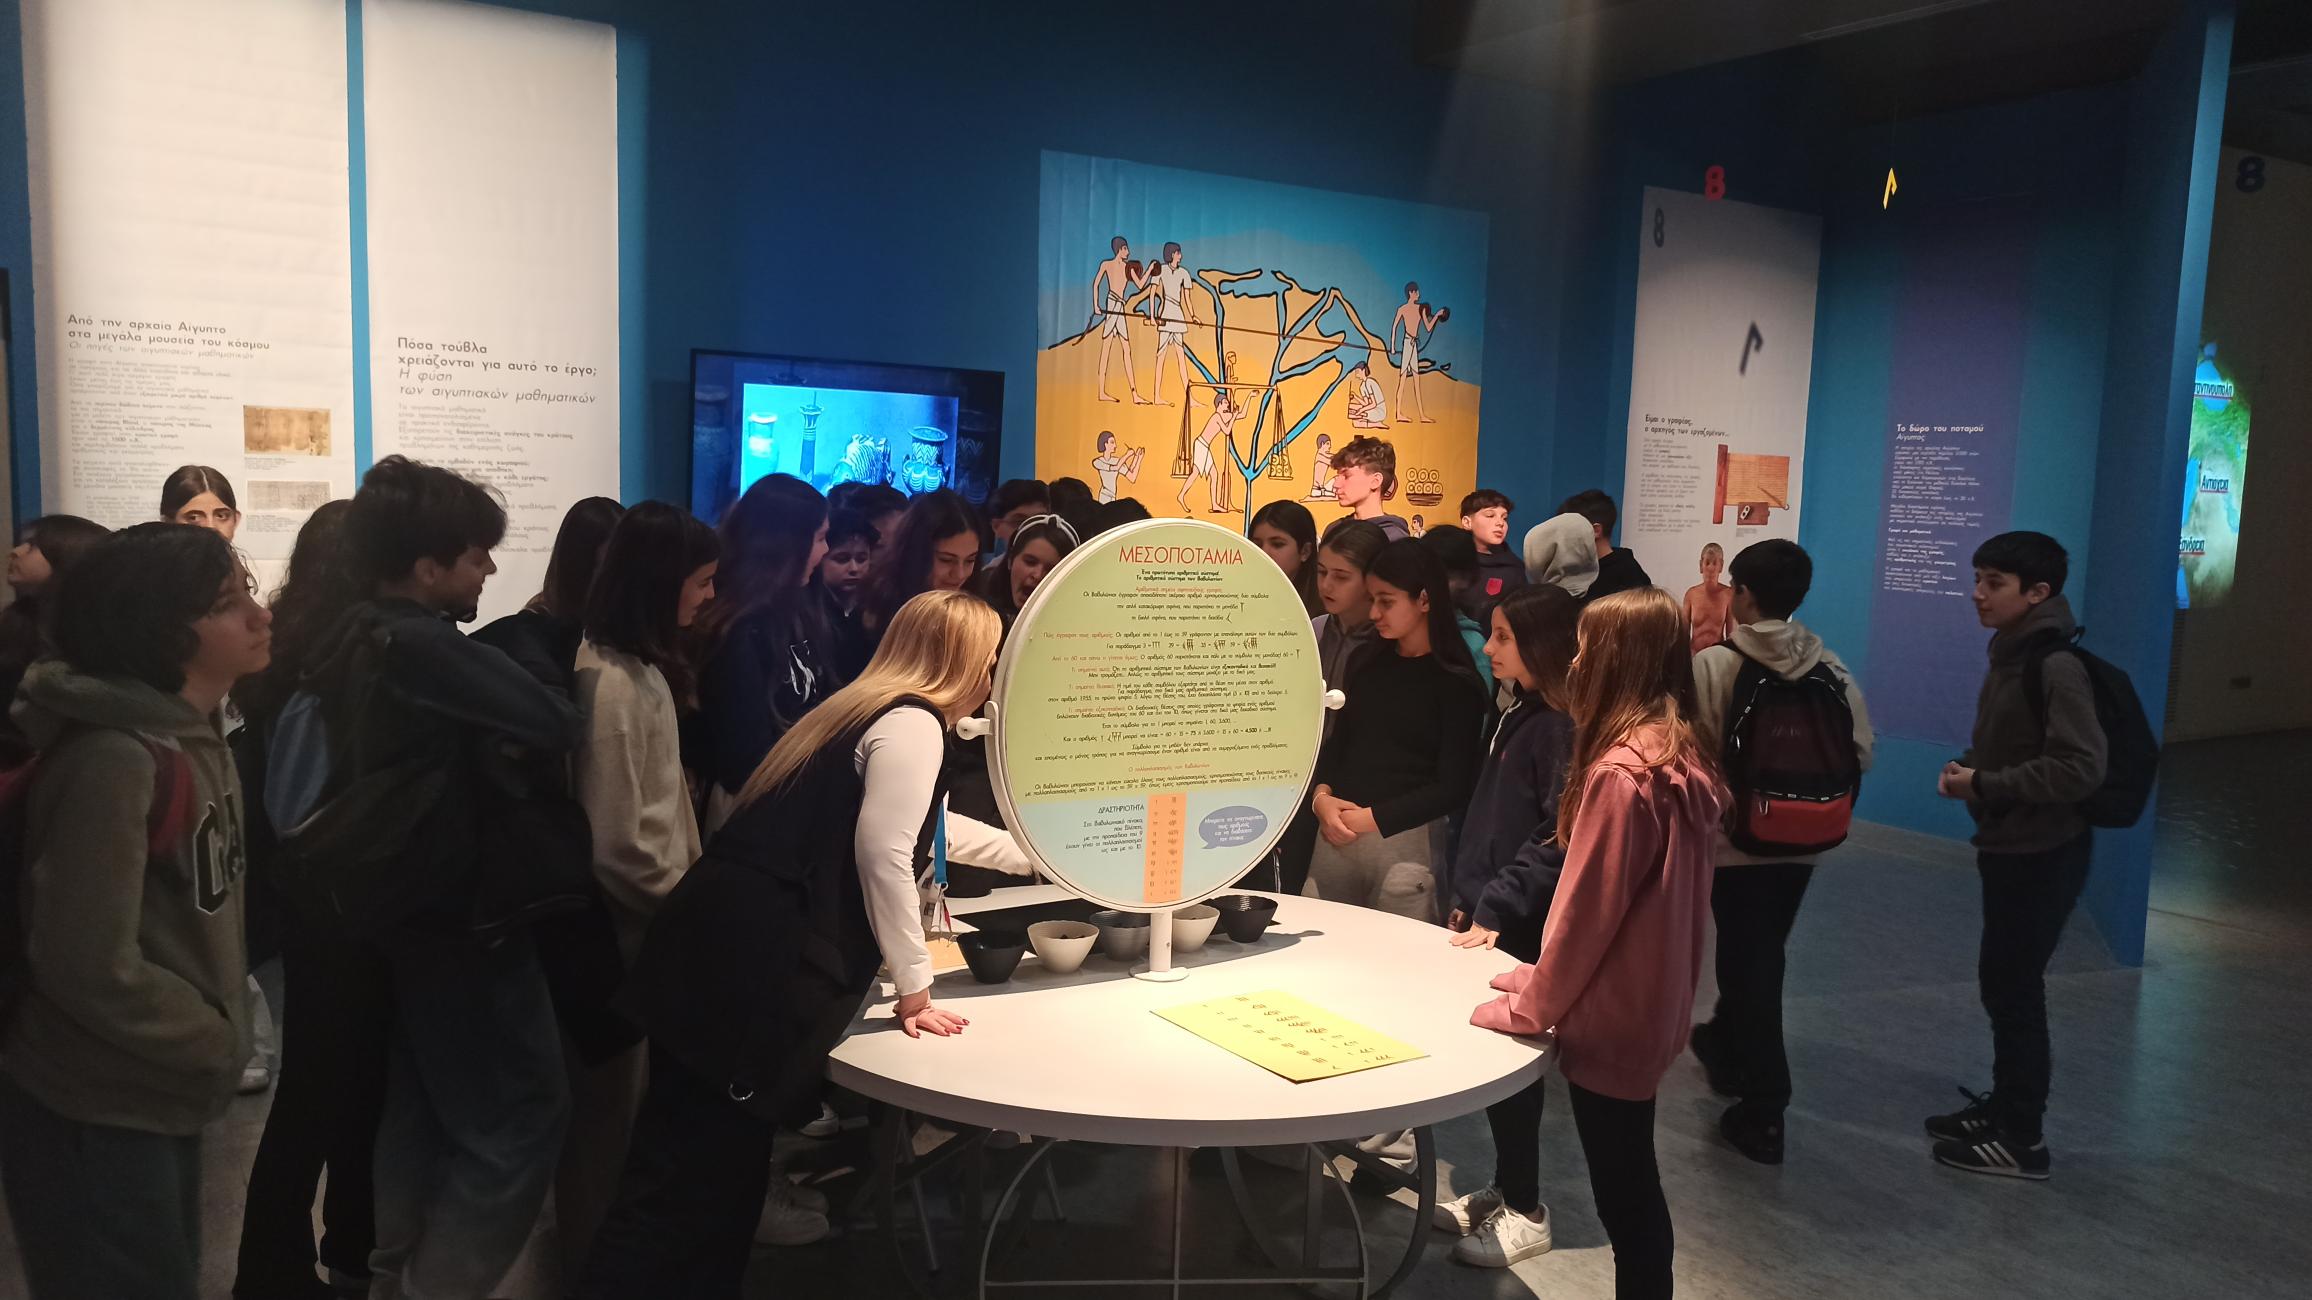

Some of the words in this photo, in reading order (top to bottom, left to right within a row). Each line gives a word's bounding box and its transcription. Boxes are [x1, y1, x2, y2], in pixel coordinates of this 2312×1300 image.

[1705, 165, 1725, 200] 8
[67, 313, 94, 326] Από
[100, 319, 122, 328] την
[68, 330, 92, 339] στα
[98, 330, 142, 342] μεγάλα
[148, 335, 194, 345] μουσεία
[200, 338, 222, 346] του
[228, 338, 270, 350] κόσμου
[398, 336, 433, 351] Πόσα
[440, 340, 488, 354] τούβλα
[398, 354, 474, 369] χρειάζονται
[482, 361, 501, 372] για
[508, 361, 538, 372] αυτό
[565, 362, 598, 377] έργο;
[399, 368, 410, 379] Η
[418, 370, 453, 383] φύση
[400, 386, 424, 395] των
[432, 387, 508, 400] αιγυπτιακών
[516, 388, 596, 404] μαθηματικών
[1896, 424, 1906, 432] Το
[1909, 424, 1930, 434] δώρο
[1950, 424, 1984, 434] ποταμού
[1119, 546, 1244, 565] ΜΕΣΟΠΟΤΑΜΙΑ
[1098, 804, 1144, 814] ΔΡΑΣΤΗΡΙΟΤΗΤΑ
